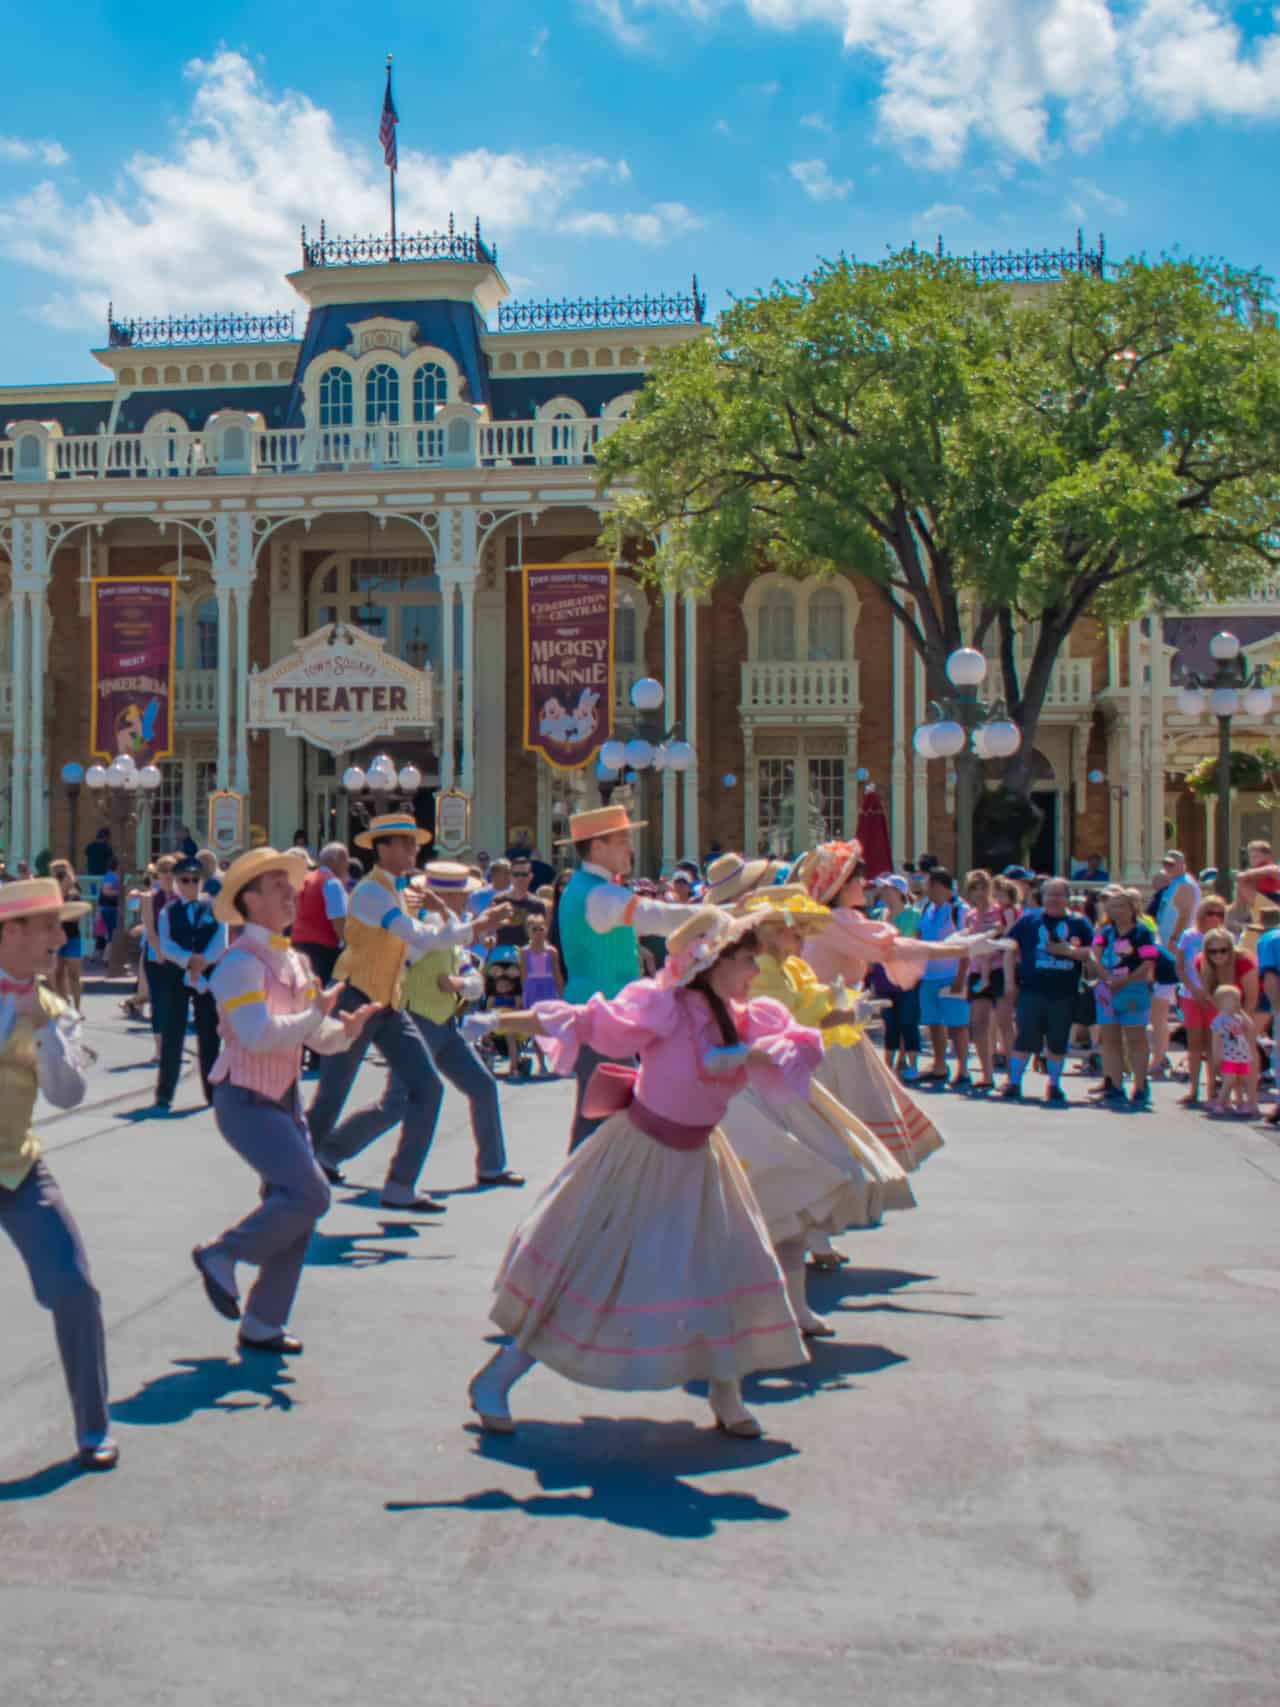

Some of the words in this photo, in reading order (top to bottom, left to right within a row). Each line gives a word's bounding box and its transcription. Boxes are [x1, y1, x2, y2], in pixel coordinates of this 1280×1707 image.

[531, 593, 607, 614] CELEBRATION
[549, 603, 607, 621] CENTRAL
[531, 640, 608, 661] MICKEY
[531, 663, 608, 685] MINNIE
[272, 685, 408, 712] THEATER
